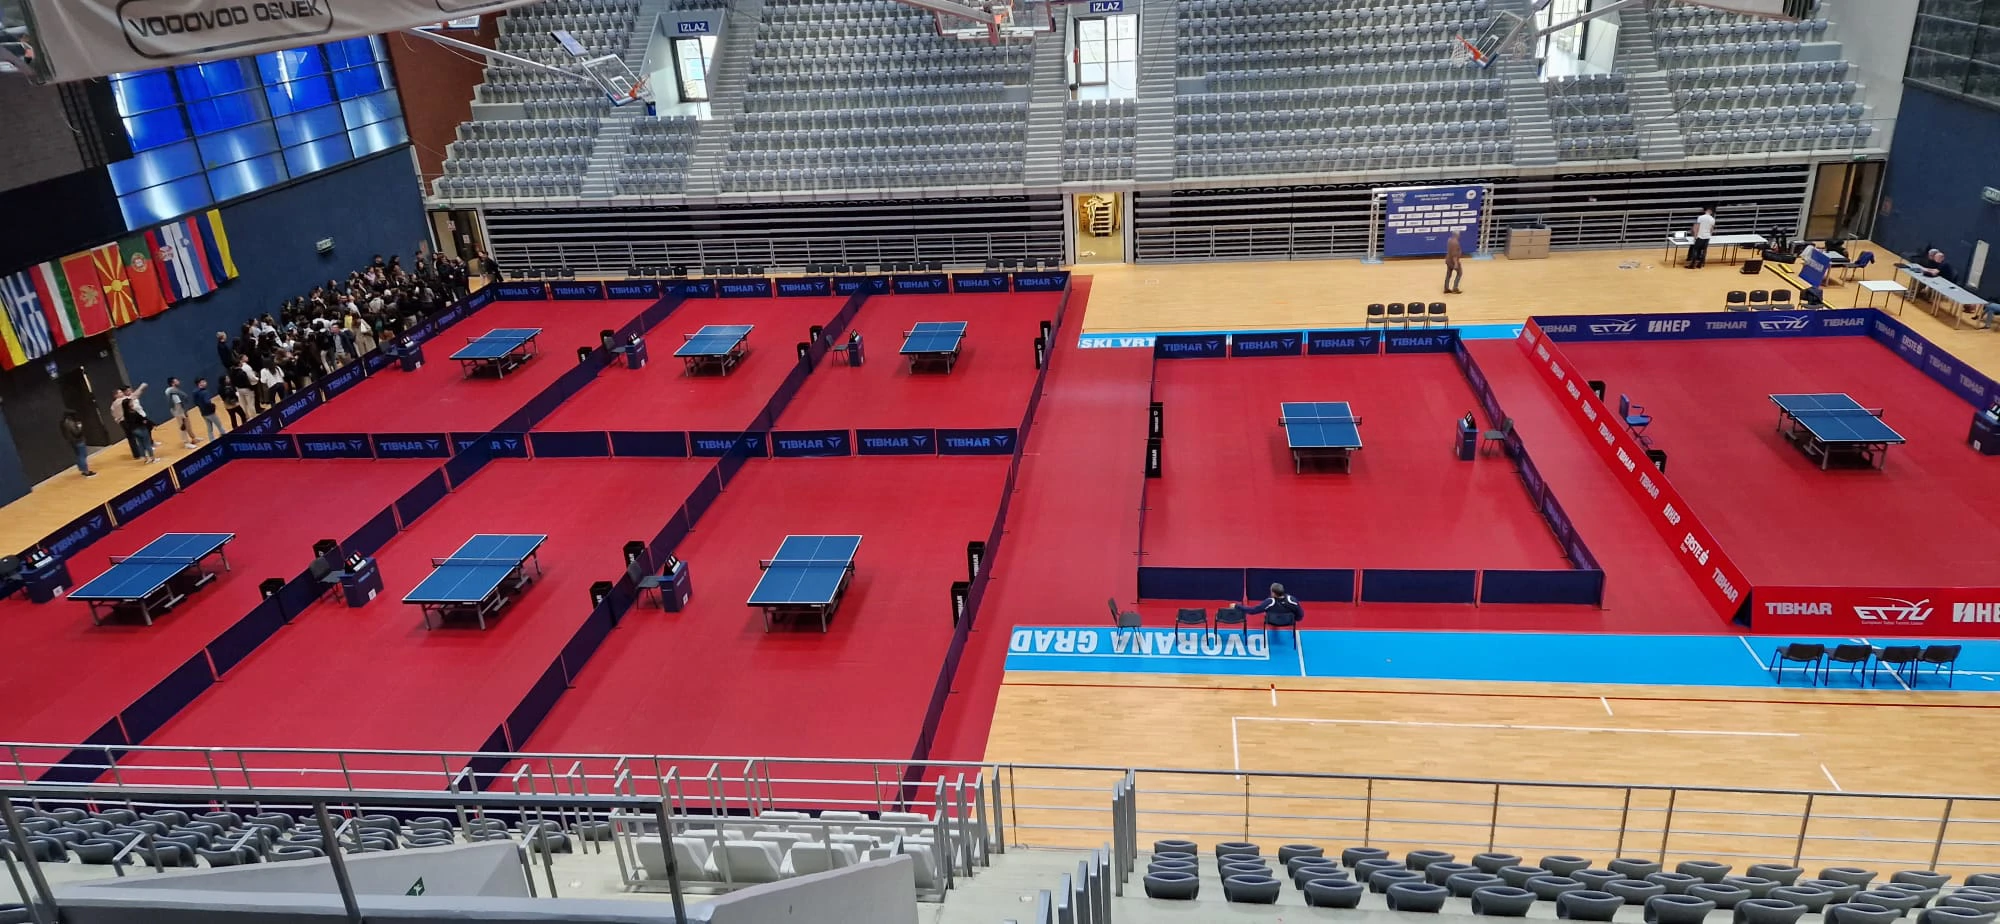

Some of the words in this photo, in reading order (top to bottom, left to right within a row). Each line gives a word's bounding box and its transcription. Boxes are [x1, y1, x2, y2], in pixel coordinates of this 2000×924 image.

[1093, 2, 1120, 12] IZLAZ
[127, 6, 249, 38] VODOVOD
[255, 0, 324, 22] OSIJEK
[680, 22, 706, 32] IZLAZ
[1589, 321, 1637, 332] ETTU
[1706, 321, 1748, 330] TIBHAR
[1760, 318, 1809, 329] ETTU
[1823, 318, 1865, 327] TIBHAR
[1238, 341, 1278, 350] TIBHAR
[1315, 339, 1355, 348] TIBHAR
[1391, 337, 1433, 347] TIBHAR
[1163, 343, 1203, 352] TIBHAR
[230, 442, 273, 451] TIBHAR
[305, 442, 347, 451] TIBHAR
[380, 441, 424, 451] TIBHAR
[697, 440, 737, 449] TIBHA
[779, 439, 824, 449] TIBHAR
[864, 437, 909, 447] TIBHAR
[945, 437, 991, 447] TIBHAR
[1712, 567, 1739, 603] TIBHAR
[1764, 602, 1833, 615] TIBHAR
[1853, 602, 1934, 620] ETTU
[1010, 630, 1098, 653] GRAD
[1111, 631, 1268, 656] DVORANA
